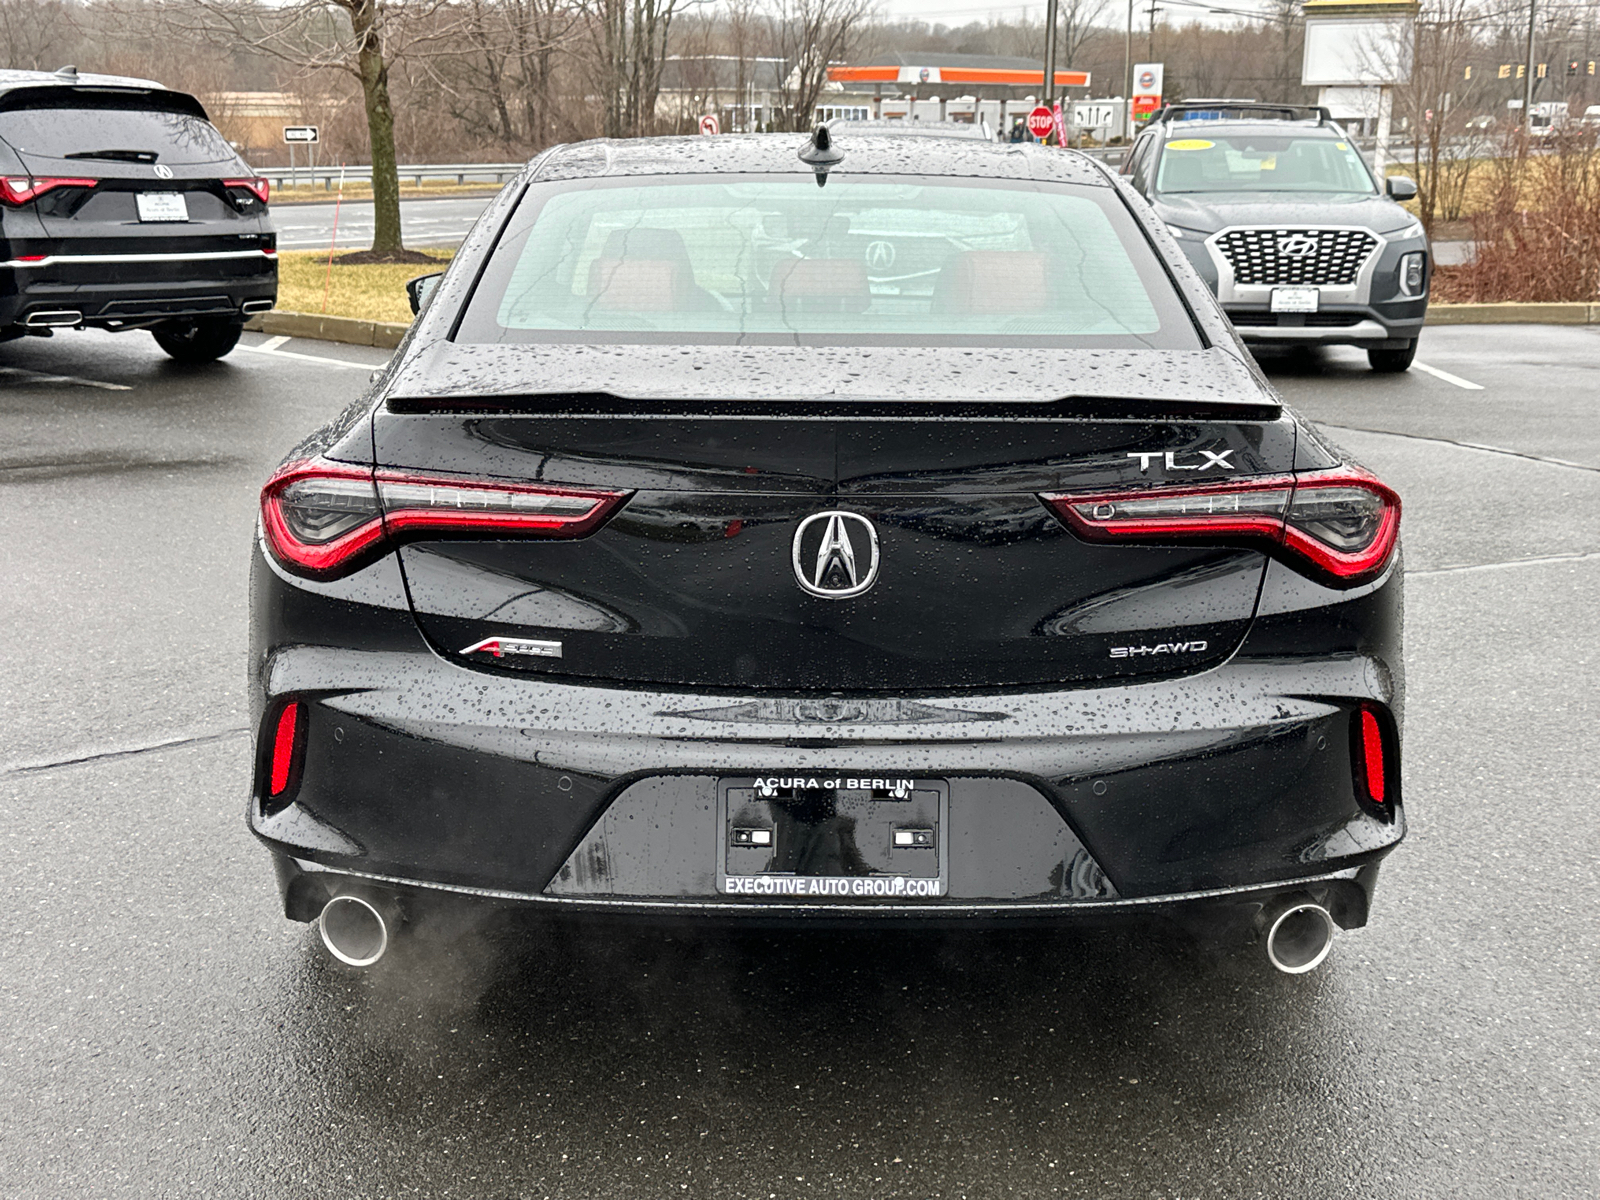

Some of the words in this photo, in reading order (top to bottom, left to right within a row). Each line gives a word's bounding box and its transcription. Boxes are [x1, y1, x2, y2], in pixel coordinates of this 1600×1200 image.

[1030, 115, 1053, 129] STOP
[1126, 449, 1235, 472] TLX
[1109, 640, 1208, 659] SH-AWD
[753, 777, 819, 788] ACURA
[823, 778, 842, 789] of
[846, 779, 914, 790] BERLIN
[725, 878, 806, 894] EXECUTIVE
[808, 878, 850, 895] AUTO
[852, 879, 940, 896] GROUP.COM
